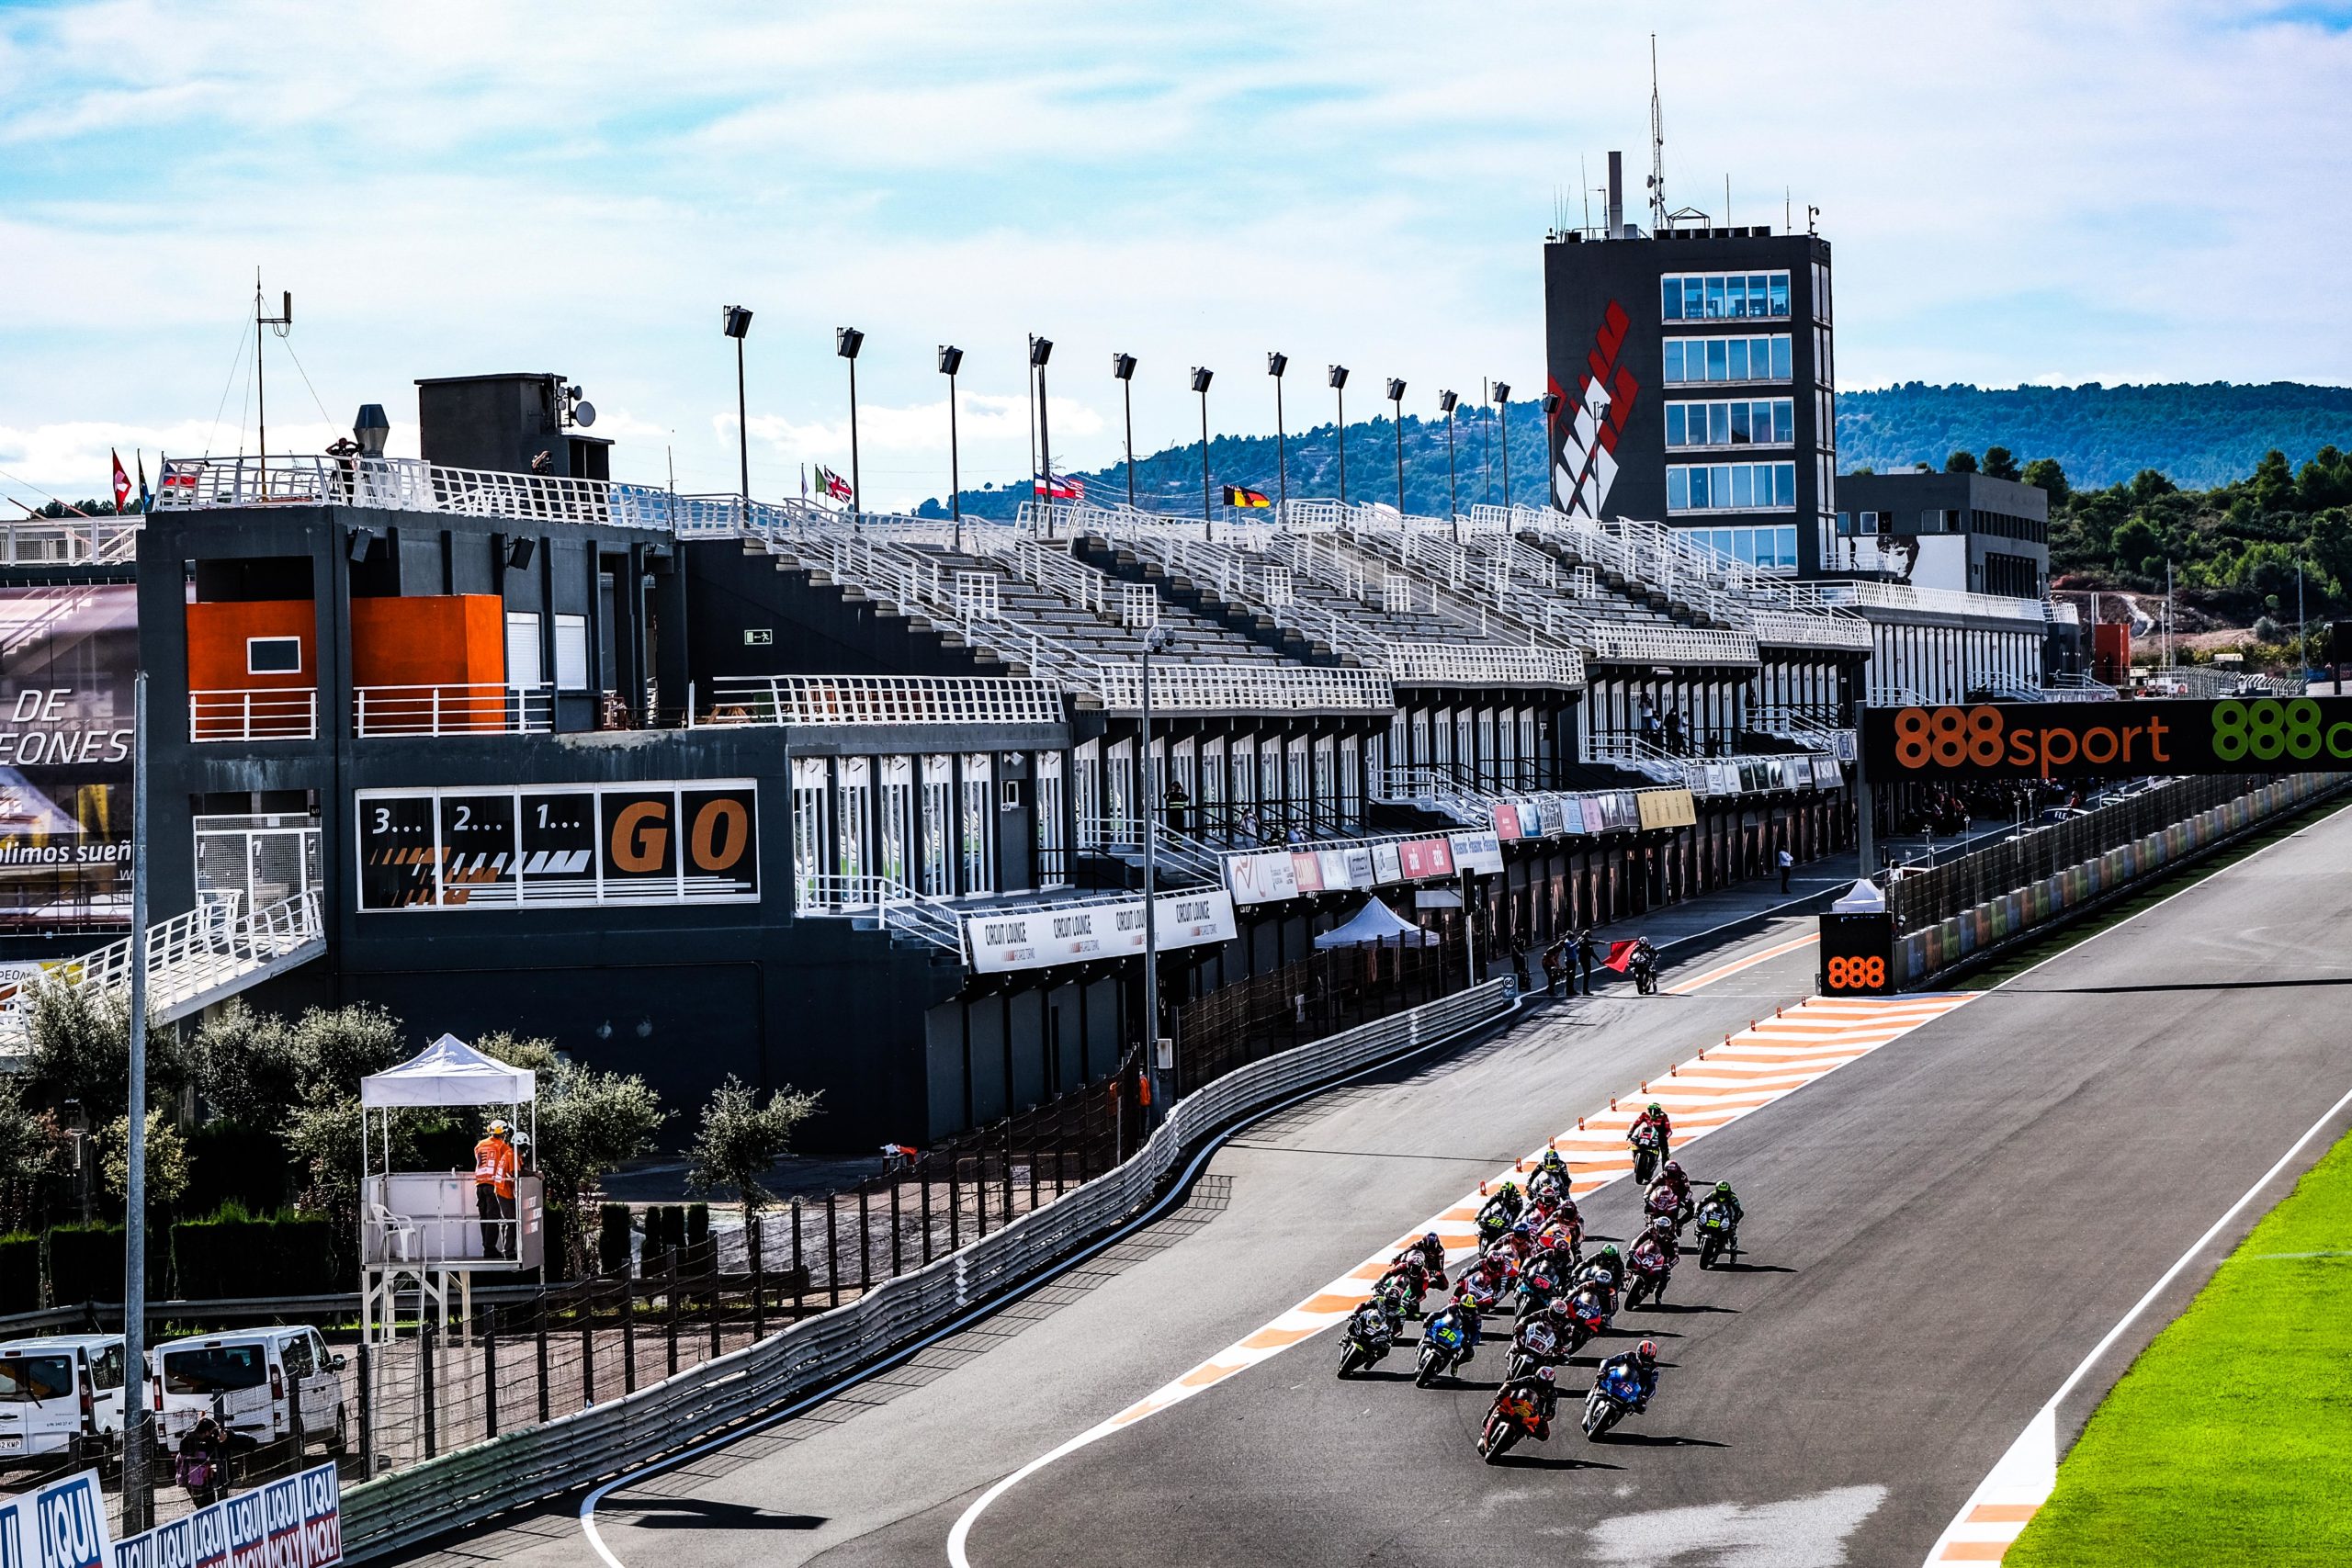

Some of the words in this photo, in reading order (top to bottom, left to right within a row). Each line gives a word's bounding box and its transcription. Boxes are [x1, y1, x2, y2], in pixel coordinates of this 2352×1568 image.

[11, 688, 72, 723] DE
[1894, 705, 2170, 778] 888sport
[0, 841, 70, 863] limos
[611, 798, 748, 873] GO
[1053, 917, 1071, 939] CIRCUIT
[1072, 914, 1091, 936] LOUNGE
[1116, 909, 1133, 931] CIRCUIT
[1134, 908, 1147, 930] LOUN
[1176, 902, 1192, 923] CIRCUIT
[1193, 900, 1210, 921] LOUNGE
[985, 924, 1005, 945] CIRCUIT
[1006, 921, 1027, 943] LOUNGE
[1828, 955, 1885, 989] 888
[1641, 1258, 1654, 1268] 04
[1438, 1327, 1458, 1342] 36
[266, 1483, 299, 1532] LIQUI
[302, 1469, 336, 1518] LIQUI
[40, 1487, 98, 1568] LIQUI
[193, 1509, 224, 1561] LIQUI
[228, 1496, 262, 1547] LIQUI
[306, 1516, 339, 1565] MOLY
[158, 1524, 190, 1568] LIQUI
[269, 1530, 301, 1568] MOLY
